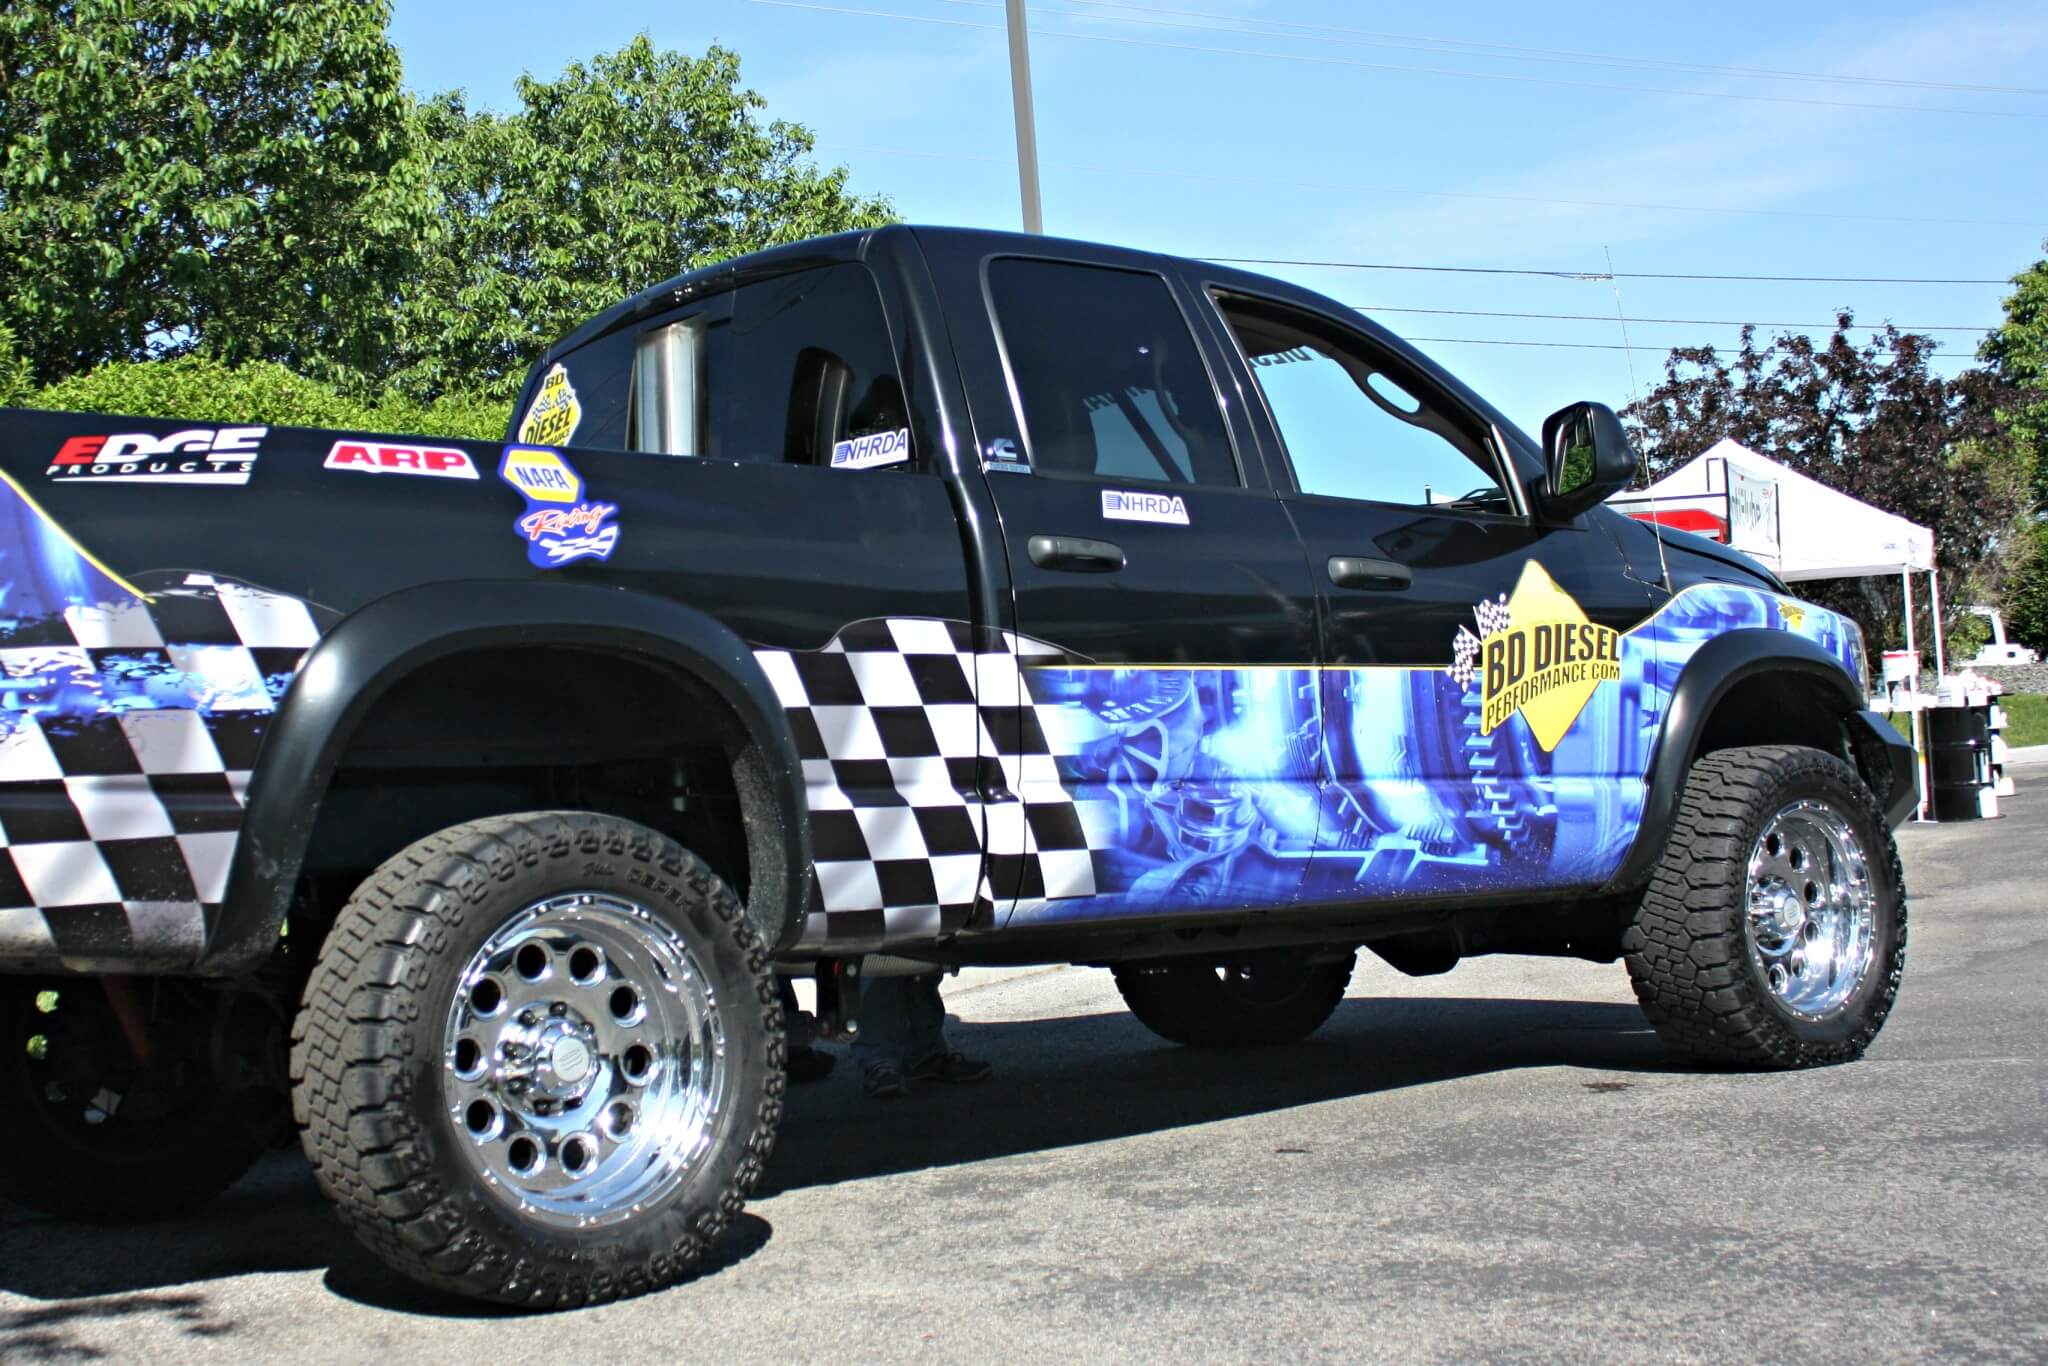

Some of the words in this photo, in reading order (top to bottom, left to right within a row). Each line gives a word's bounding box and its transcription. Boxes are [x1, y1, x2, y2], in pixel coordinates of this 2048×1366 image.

[546, 373, 565, 390] BD
[525, 407, 571, 444] DIESEL
[52, 427, 268, 464] EDGE
[333, 445, 466, 471] ARP
[844, 431, 906, 460] NHRDA
[46, 461, 253, 475] PRODUCTS
[515, 466, 571, 490] NAPA
[1118, 495, 1184, 514] NHRDA
[521, 504, 615, 541] Racing
[1486, 631, 1526, 701] BD
[1534, 623, 1620, 673] DIESEL
